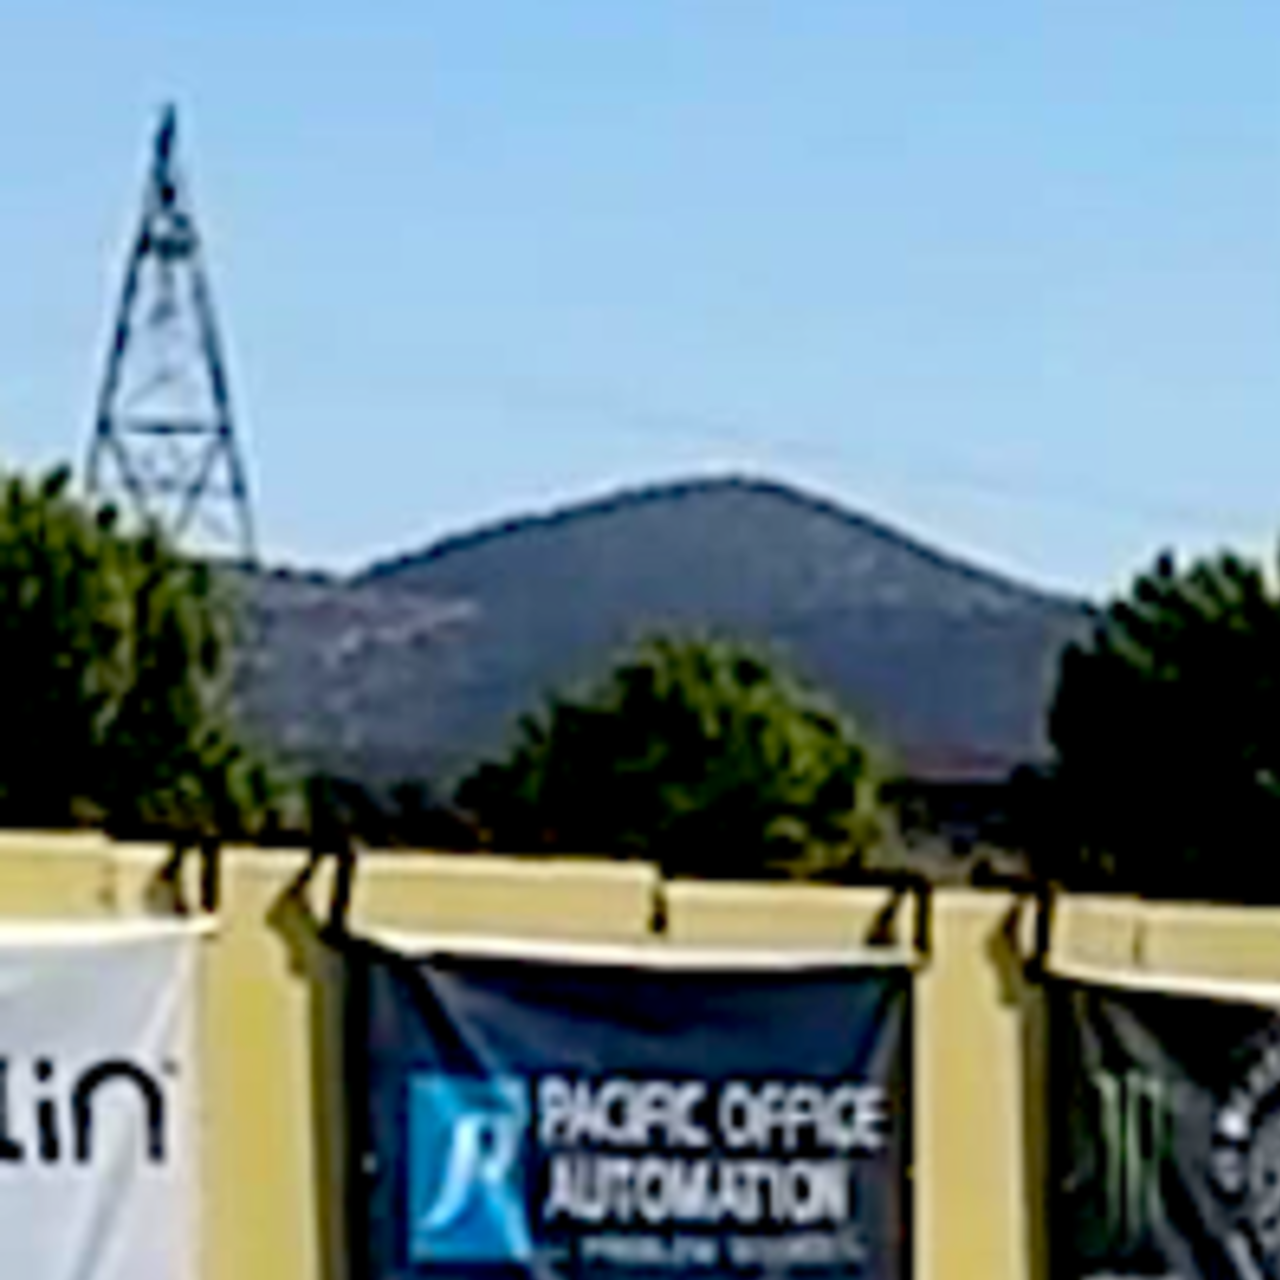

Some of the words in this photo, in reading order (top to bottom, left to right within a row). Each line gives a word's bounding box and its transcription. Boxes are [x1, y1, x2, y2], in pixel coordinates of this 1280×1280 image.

[538, 1074, 710, 1148] PACIFIC
[717, 1079, 889, 1151] OFFICE
[543, 1156, 849, 1226] AUTOMATION
